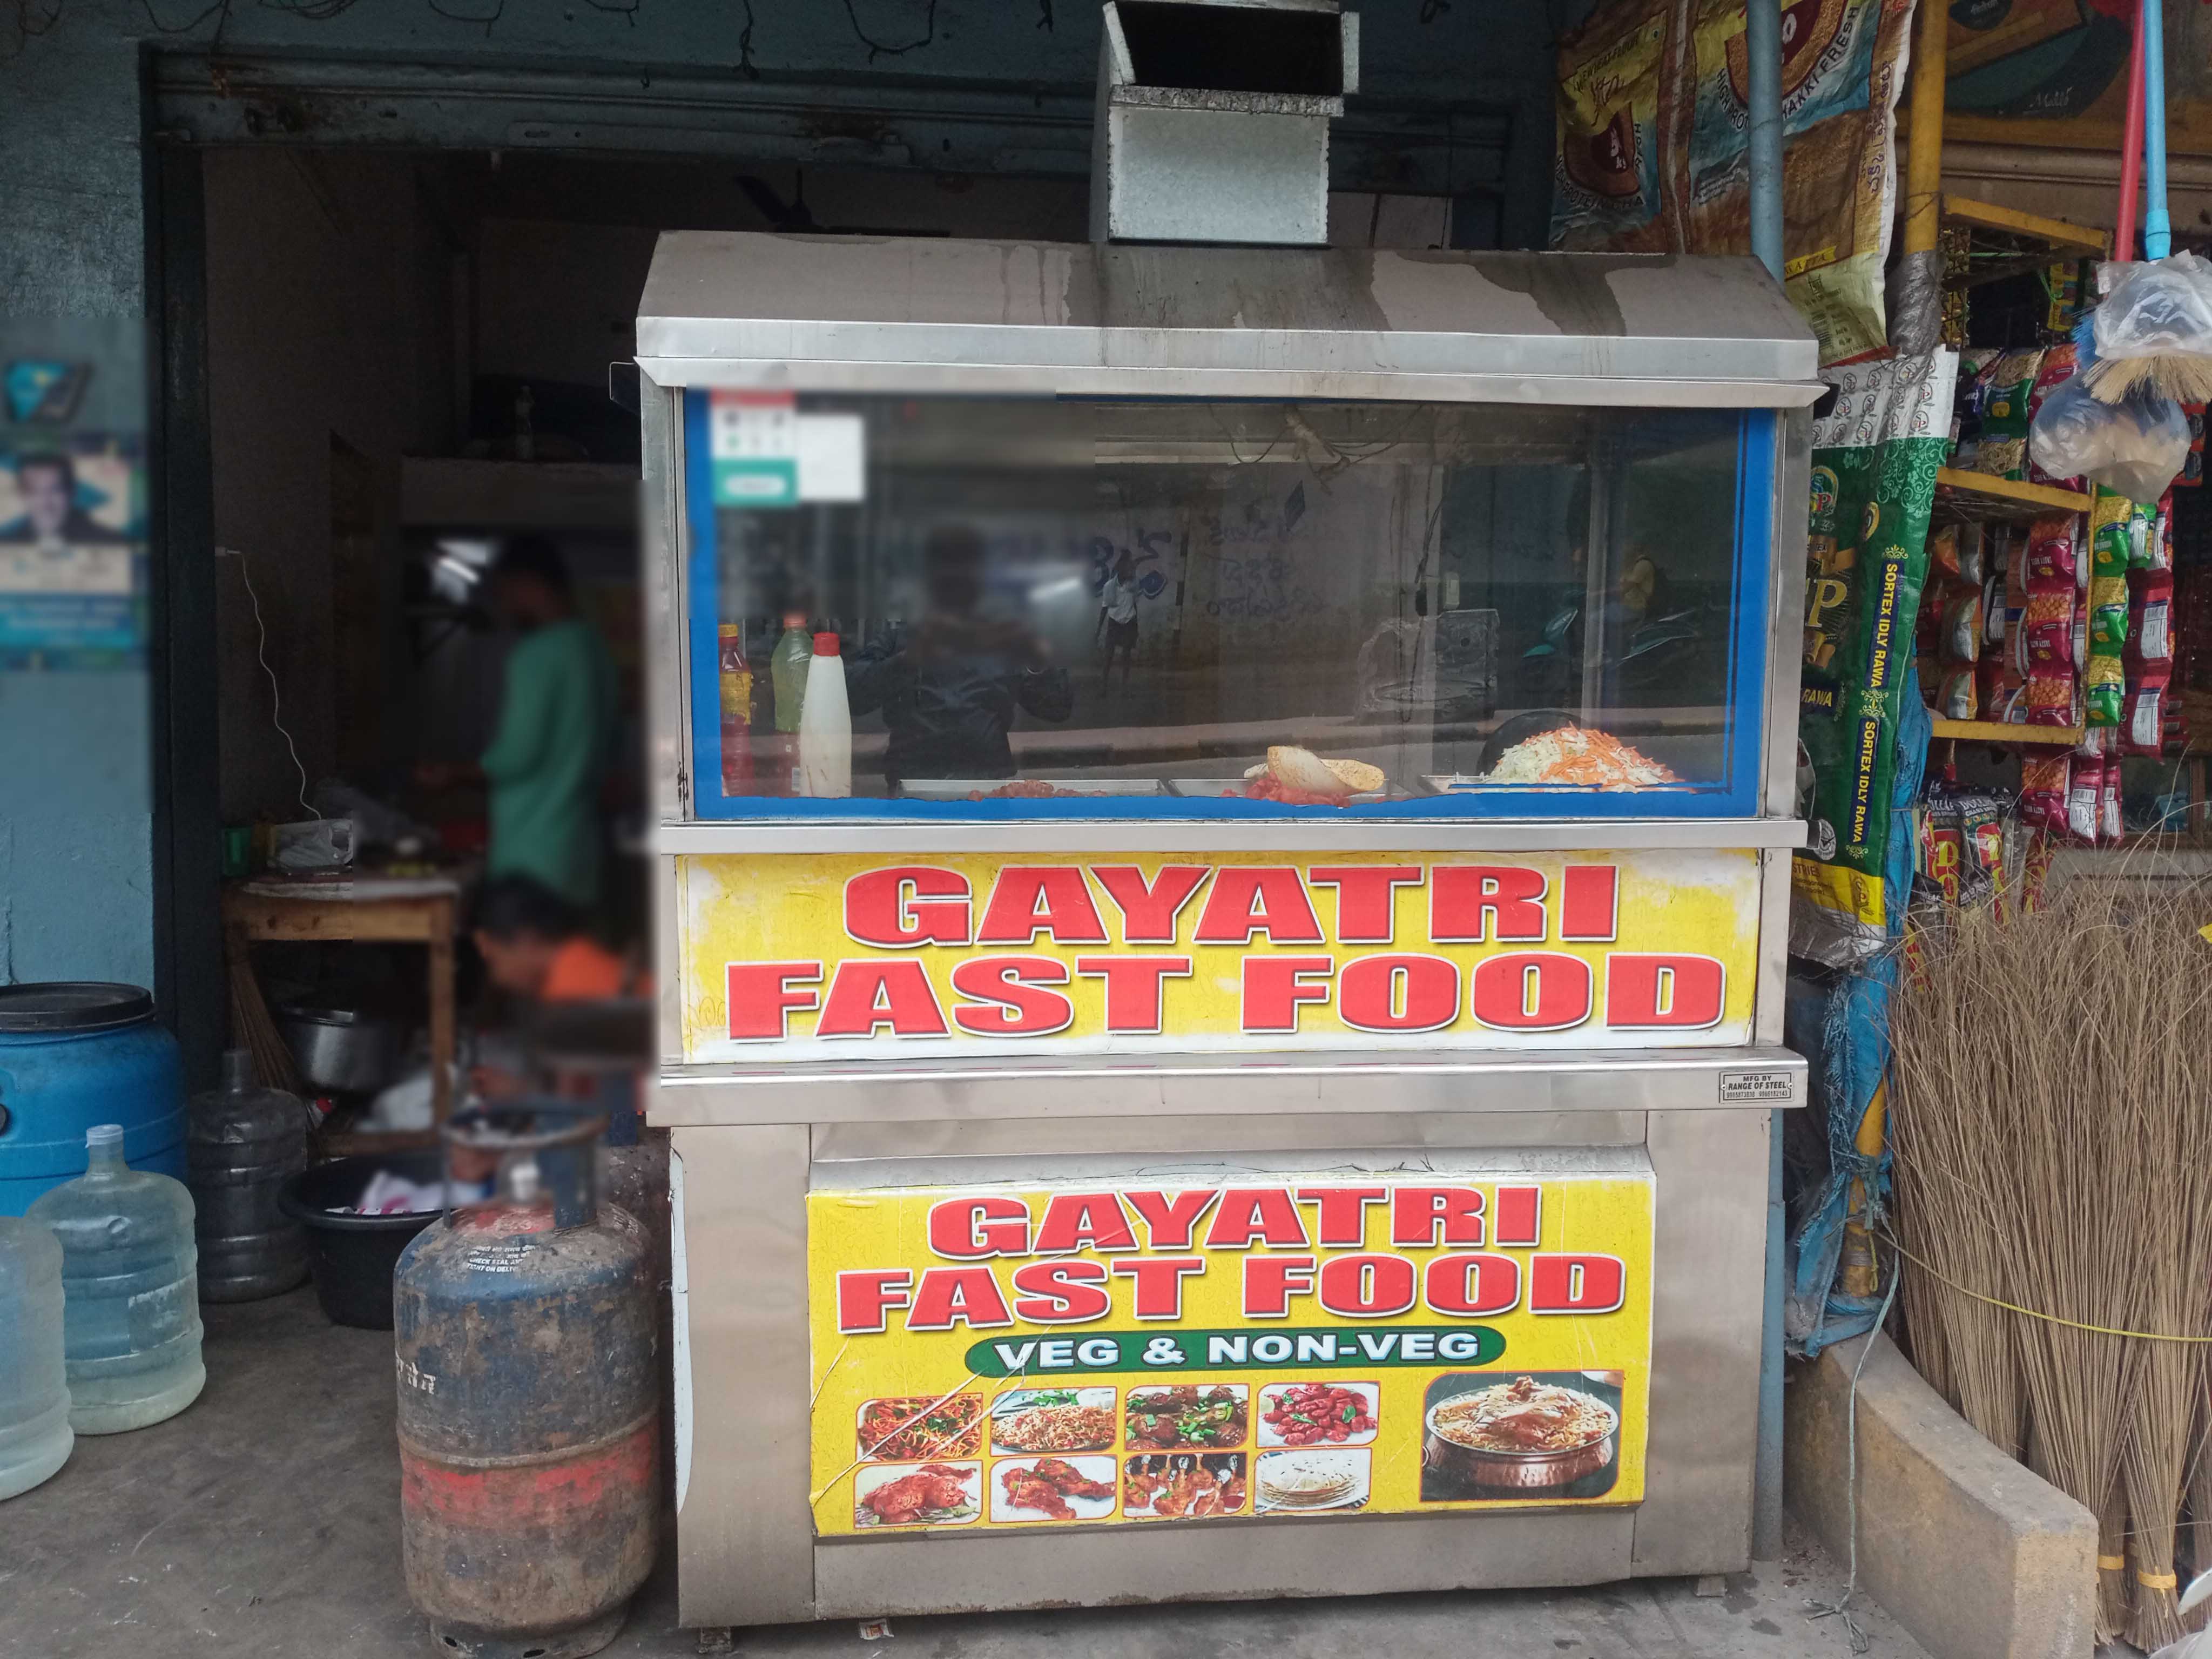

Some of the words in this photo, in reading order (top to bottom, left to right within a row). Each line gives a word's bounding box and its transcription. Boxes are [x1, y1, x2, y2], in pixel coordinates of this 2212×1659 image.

[1717, 68, 1731, 110] HIGH
[1729, 104, 1749, 130] PROT
[1820, 6, 1859, 72] FRESH
[1878, 563, 1899, 616] SORTEX
[1874, 617, 1891, 648] IDLY
[1870, 648, 1888, 689] RAWA
[1859, 721, 1876, 773] SORTEX
[1857, 773, 1872, 806] IDLY
[1852, 805, 1867, 844] RAWA
[843, 864, 1619, 949] GAYATRI
[725, 955, 1193, 1043] FAST
[1238, 951, 1727, 1034] FOOD
[1728, 1082, 1752, 1090] RANGE
[1765, 1081, 1786, 1089] STEEL
[927, 1184, 1543, 1260] GAYATRI
[835, 1256, 1206, 1334] FAST
[1242, 1252, 1626, 1319] FOOD
[993, 1337, 1121, 1370] VEG
[1142, 1336, 1186, 1365] &
[1206, 1332, 1481, 1365] NON-VEG
